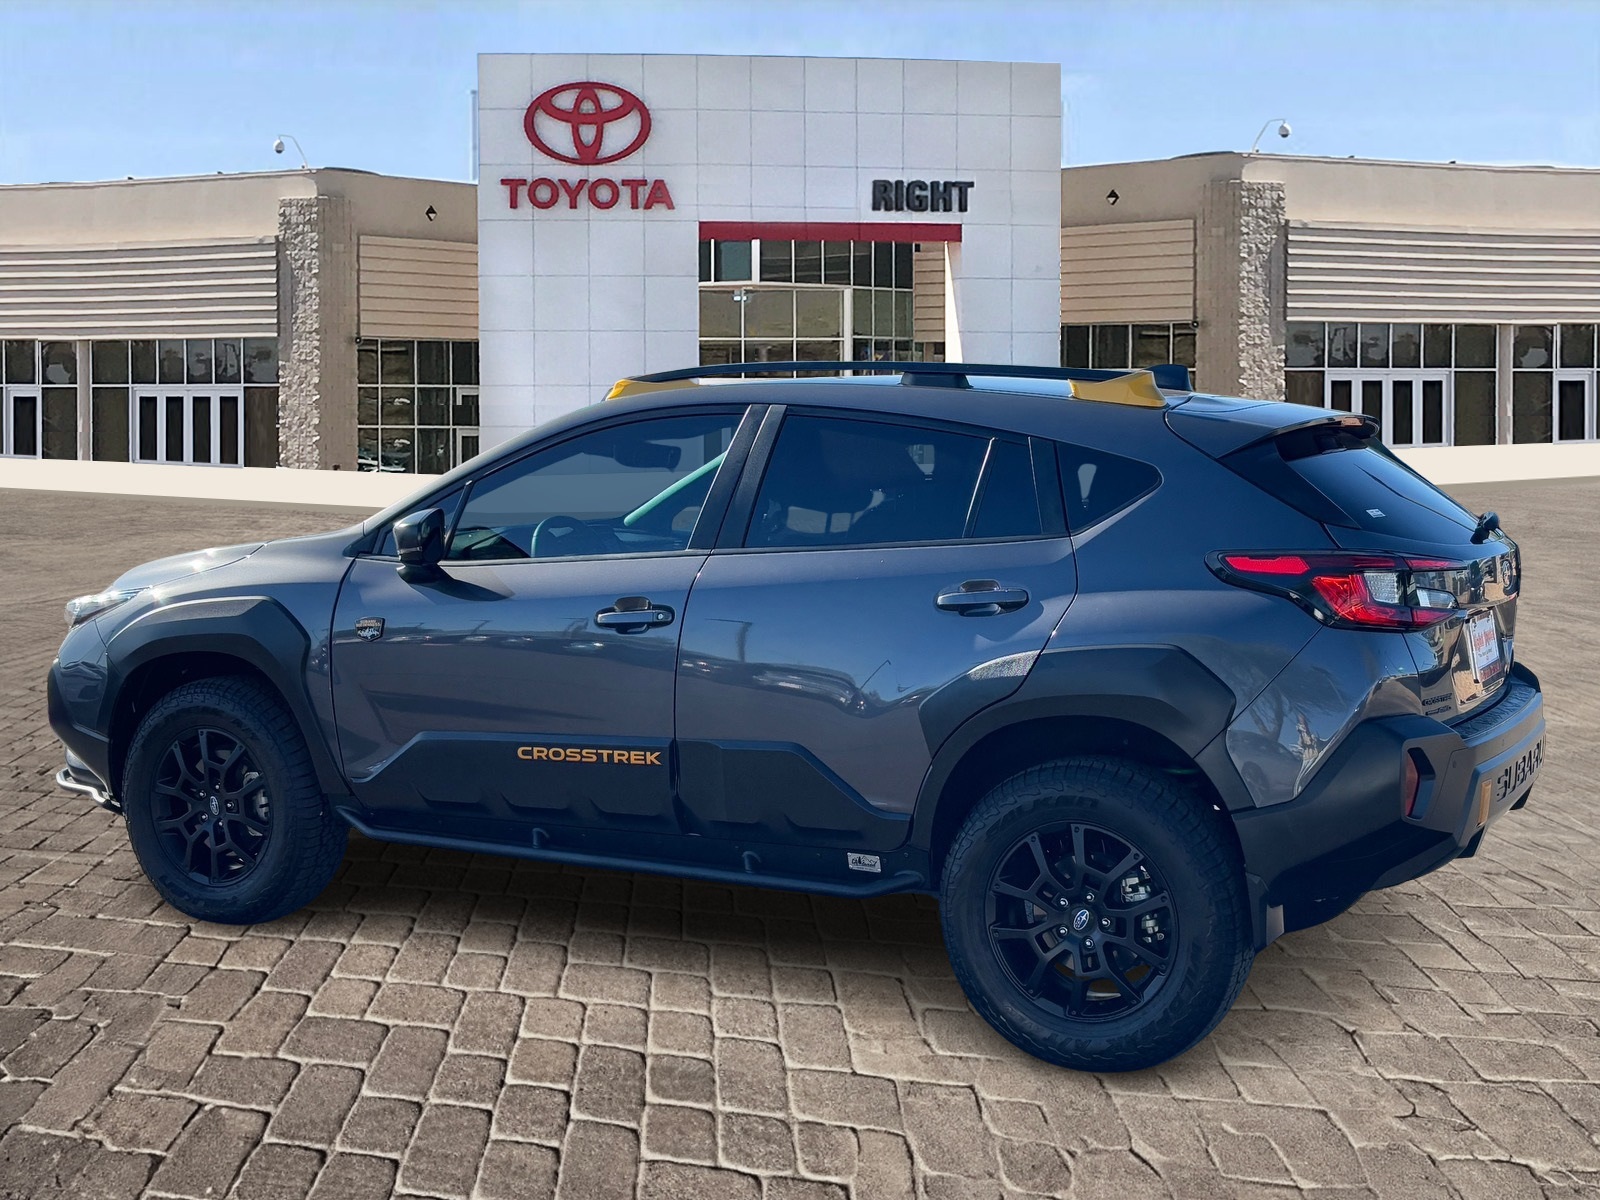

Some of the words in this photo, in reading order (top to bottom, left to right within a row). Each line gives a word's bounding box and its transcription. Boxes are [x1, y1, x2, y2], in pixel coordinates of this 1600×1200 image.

[500, 177, 675, 210] TOYOTA
[871, 179, 975, 213] RIGHT
[517, 746, 662, 765] CROSSTREK
[1496, 733, 1547, 803] SUBARU
